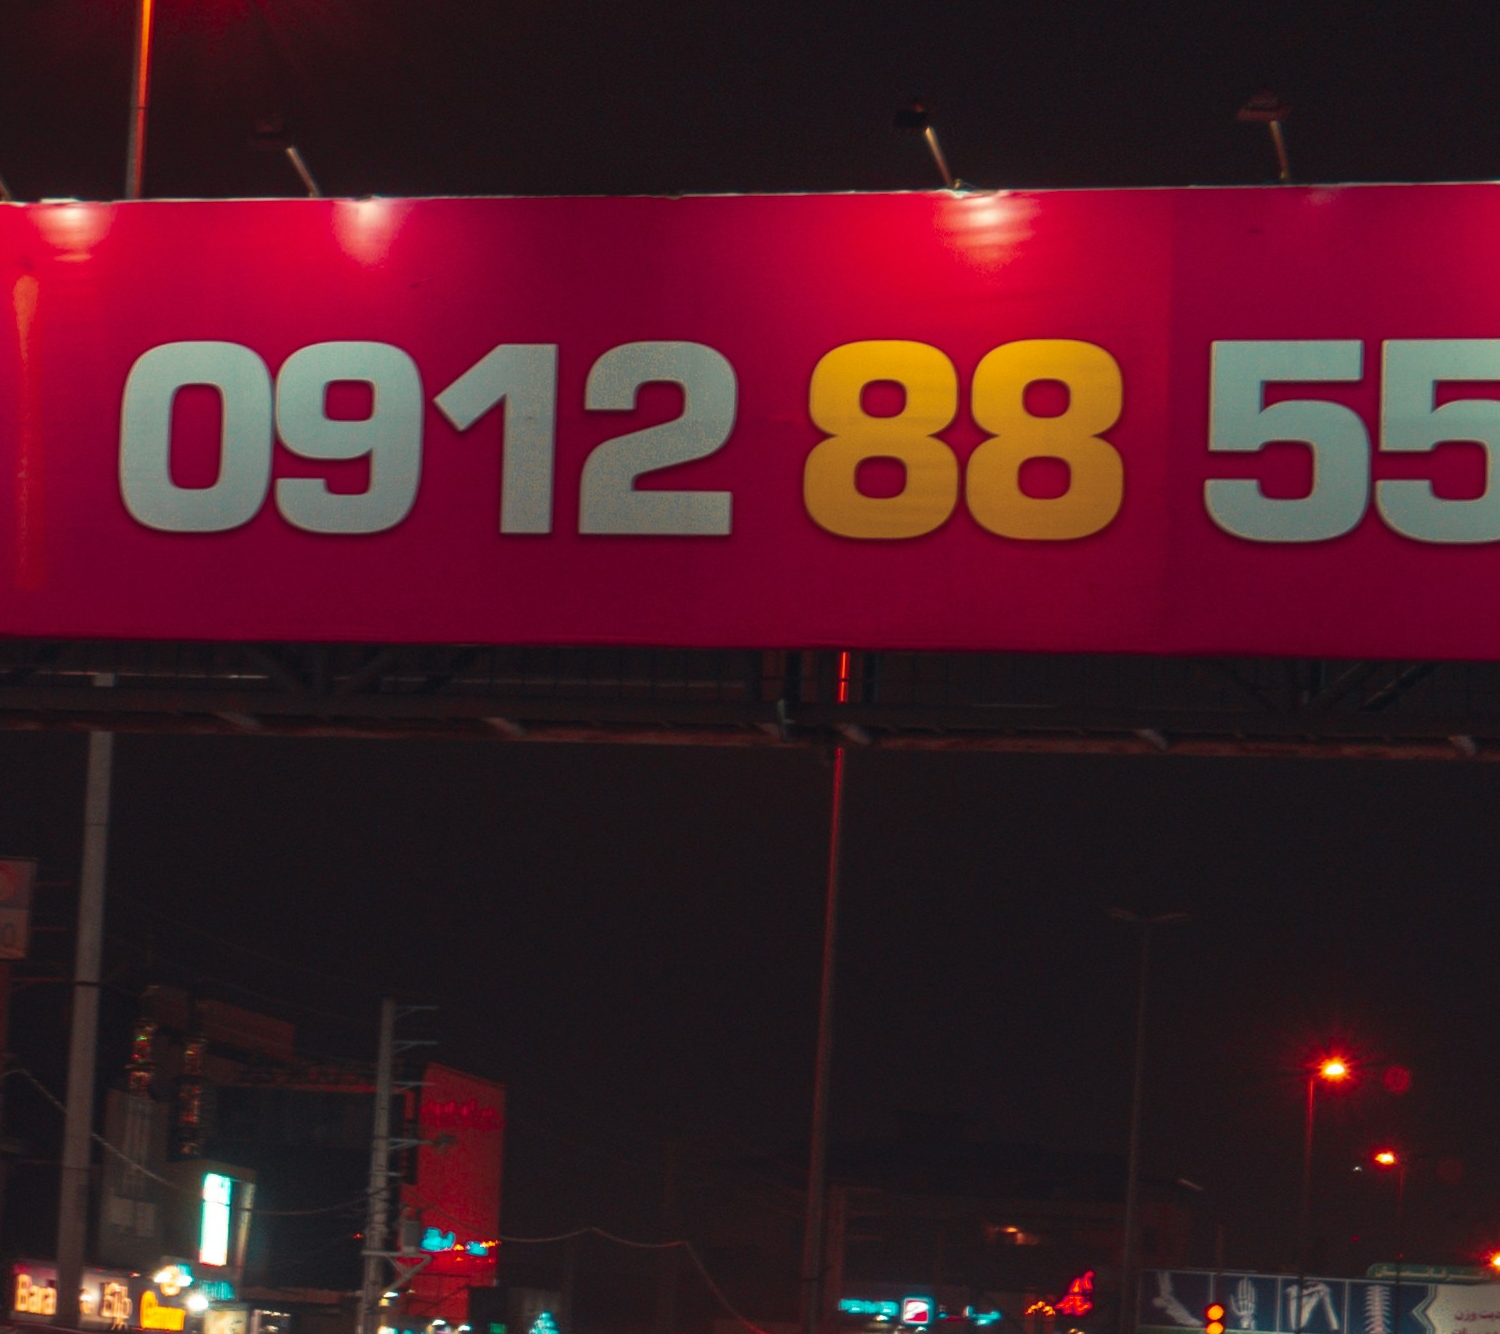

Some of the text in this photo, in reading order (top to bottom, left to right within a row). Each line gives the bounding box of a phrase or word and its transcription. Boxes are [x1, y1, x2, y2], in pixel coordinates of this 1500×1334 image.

[119, 338, 1500, 545] 0912 88 55
